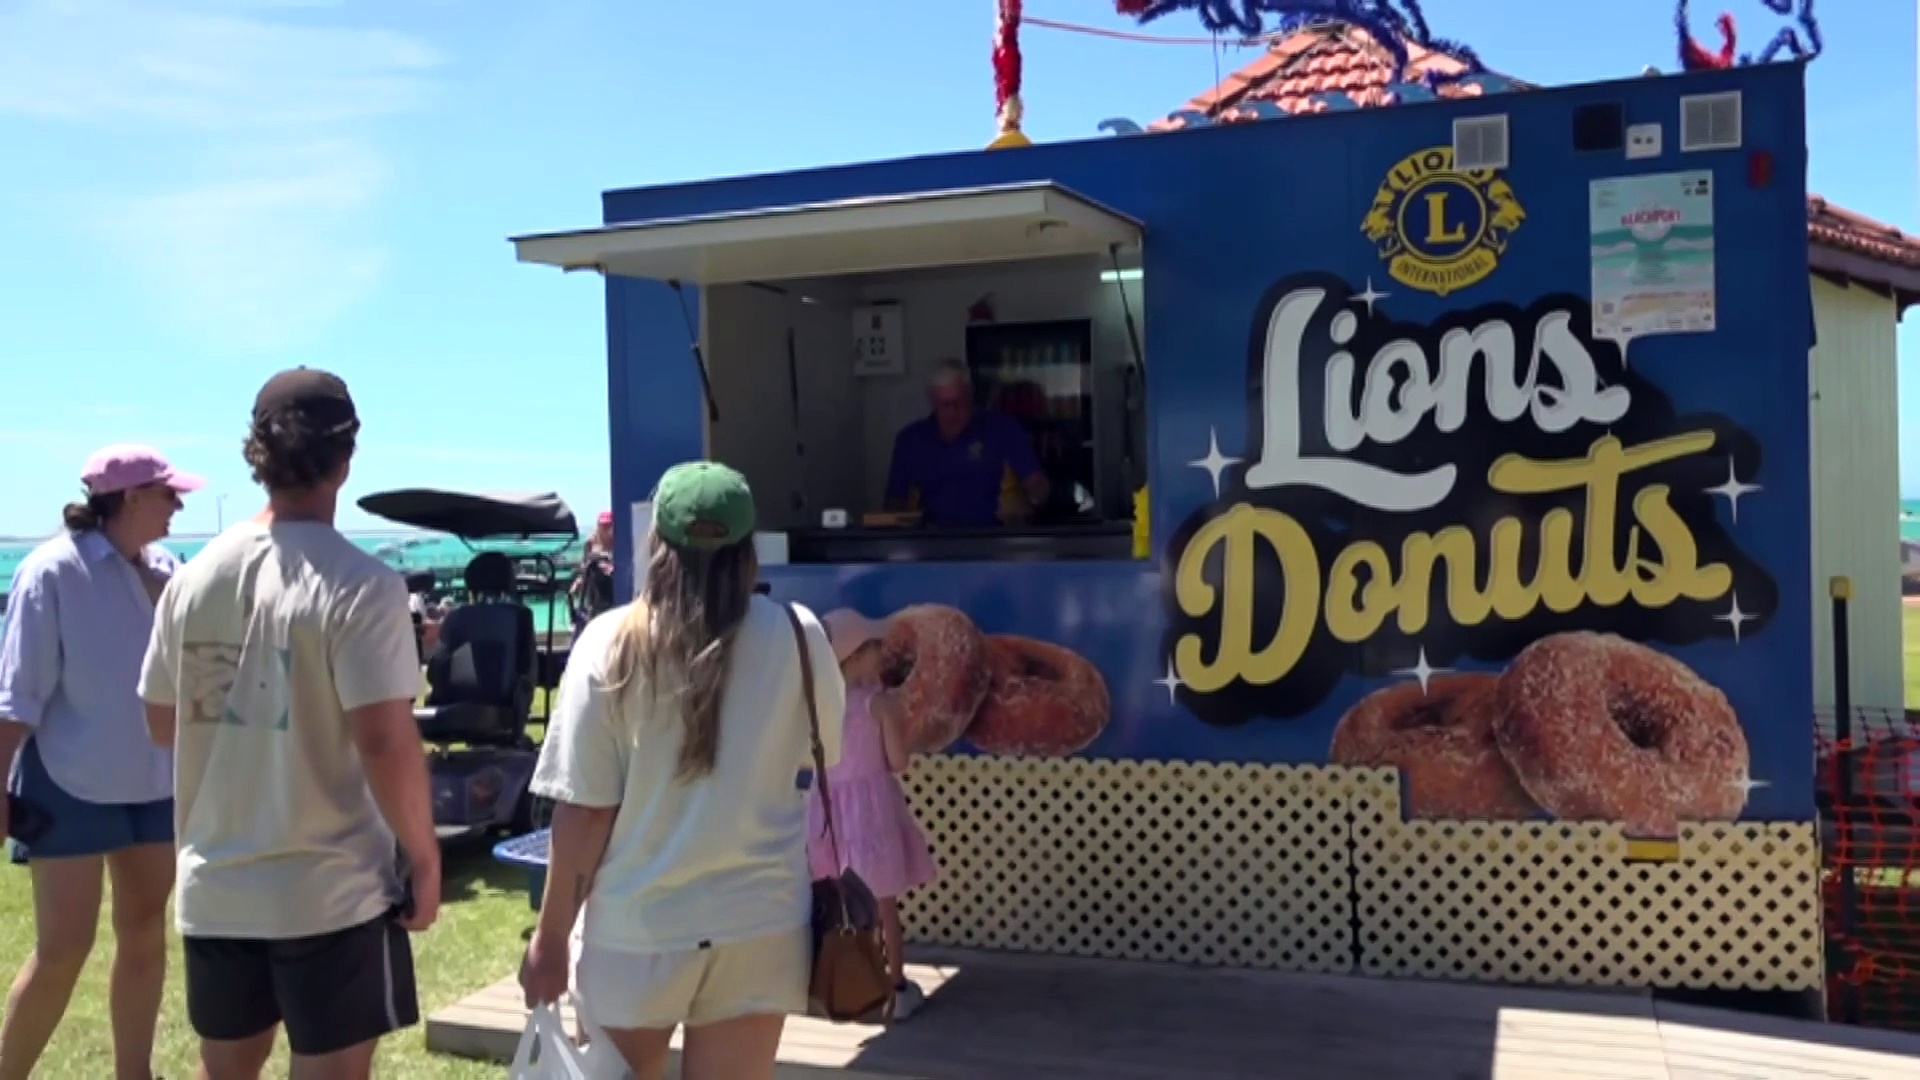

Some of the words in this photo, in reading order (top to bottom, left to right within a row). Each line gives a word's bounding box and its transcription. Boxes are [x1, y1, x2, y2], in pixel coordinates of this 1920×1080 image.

[1395, 151, 1486, 186] LIO
[1424, 192, 1466, 244] L
[1246, 288, 1631, 511] Lions
[1175, 430, 1733, 693] Donuts
